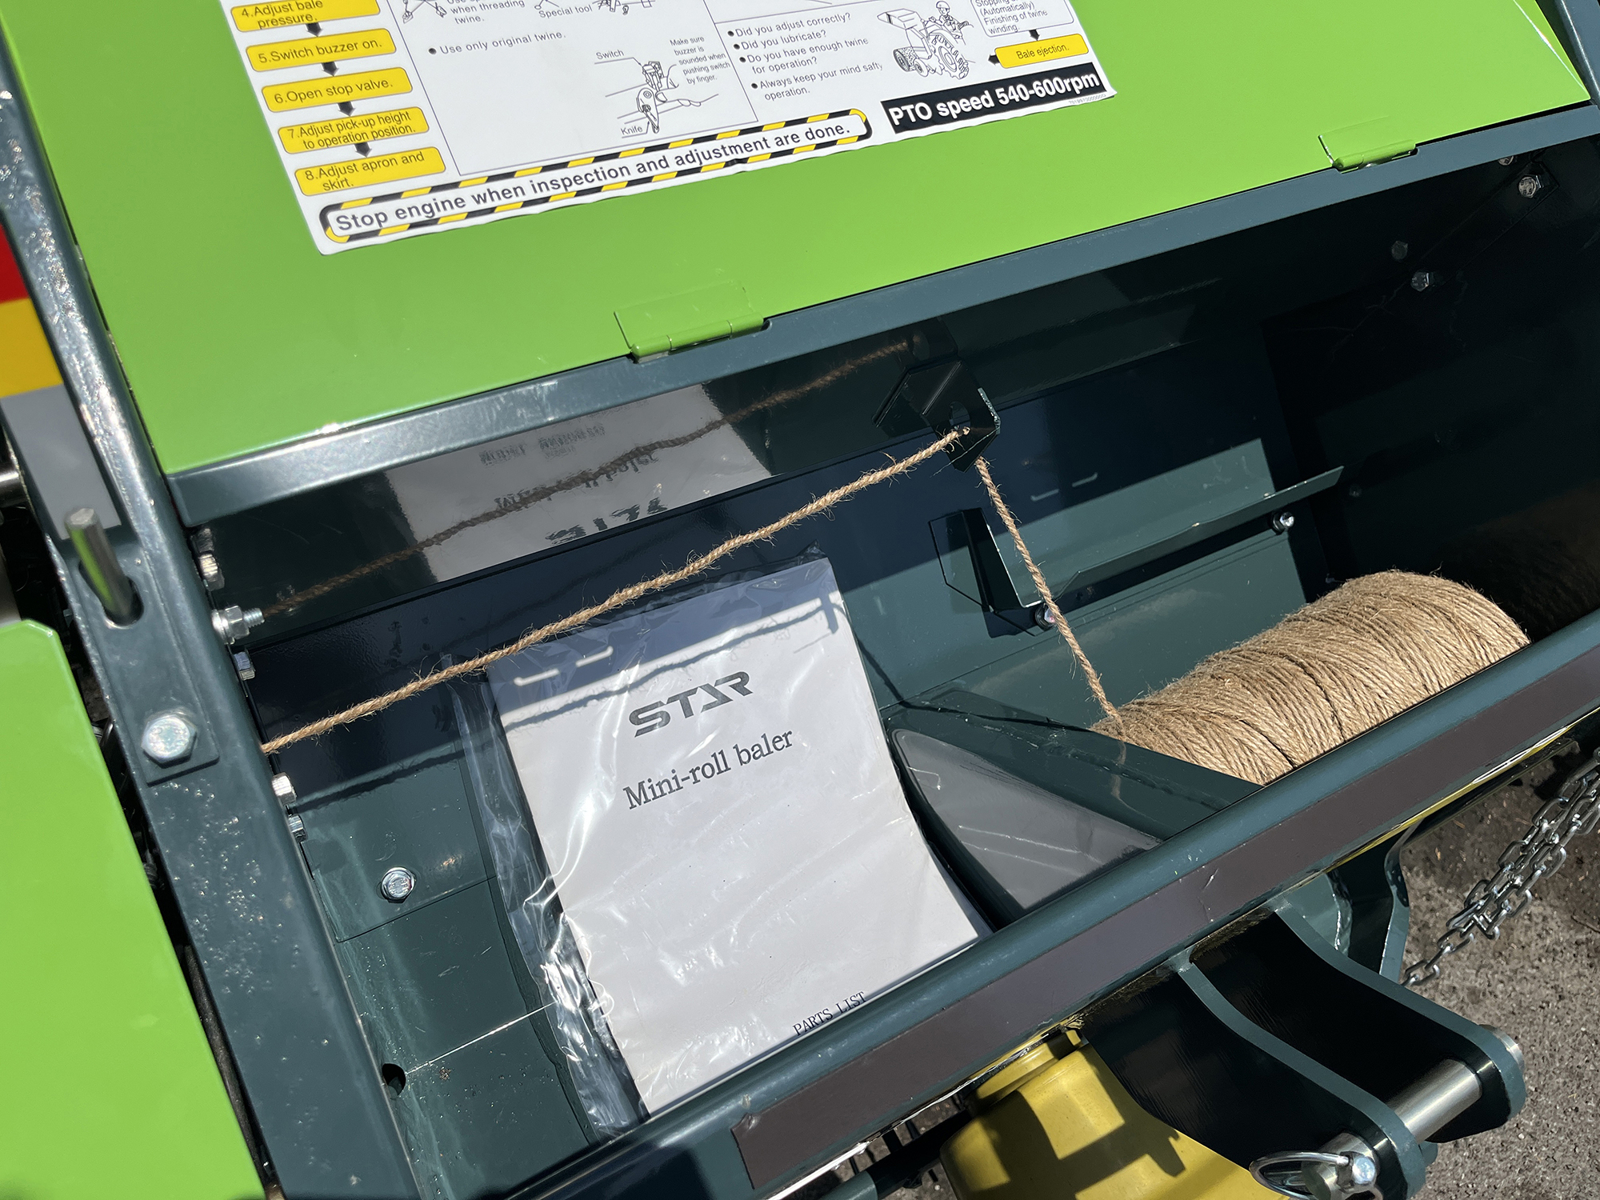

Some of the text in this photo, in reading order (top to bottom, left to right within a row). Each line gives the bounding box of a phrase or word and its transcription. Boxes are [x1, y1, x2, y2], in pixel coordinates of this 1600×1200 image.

[241, 0, 323, 18] 4.Adjust bale
[450, 0, 526, 14] when threading
[538, 5, 593, 19] Special tool
[257, 13, 317, 29] pressure.
[454, 15, 485, 24] twine.
[735, 12, 852, 37] Did you adjust correctly?
[984, 10, 1048, 25] Finishing of twine
[440, 31, 566, 55] Use only original twine.
[670, 38, 689, 46] Make
[741, 29, 827, 50] Did you lubricate?
[258, 39, 382, 63] 5.Switch buzzer on.
[596, 49, 624, 60] Switch
[674, 48, 697, 56] buzzer
[678, 53, 726, 65] sounded when
[747, 38, 869, 63] Do you have enough twine
[1016, 44, 1070, 59] Bale ejection.
[682, 61, 731, 76] pushing switch
[751, 56, 818, 75] for operation?
[687, 76, 696, 85] by
[760, 77, 793, 89] Always
[793, 72, 817, 83] keep
[818, 69, 838, 81] your
[839, 64, 861, 75] mind
[274, 78, 393, 104] 6.Open stop valve.
[764, 85, 811, 101] operation.
[888, 102, 933, 126] PTO
[936, 90, 995, 119] speed
[995, 72, 1100, 105] 540-600rpm
[288, 111, 411, 139] 7.Adjust pick-up height
[621, 125, 643, 135] Knife
[303, 124, 416, 149] to operation position.
[305, 152, 425, 181] 8.Adjust apron and
[322, 178, 354, 191] skirt.
[335, 124, 851, 232] Stop engine when inspection and adjustment are done.
[628, 671, 754, 738] STAR
[622, 730, 793, 810] Mini-roll baler
[792, 991, 867, 1036] PARTS LIST
